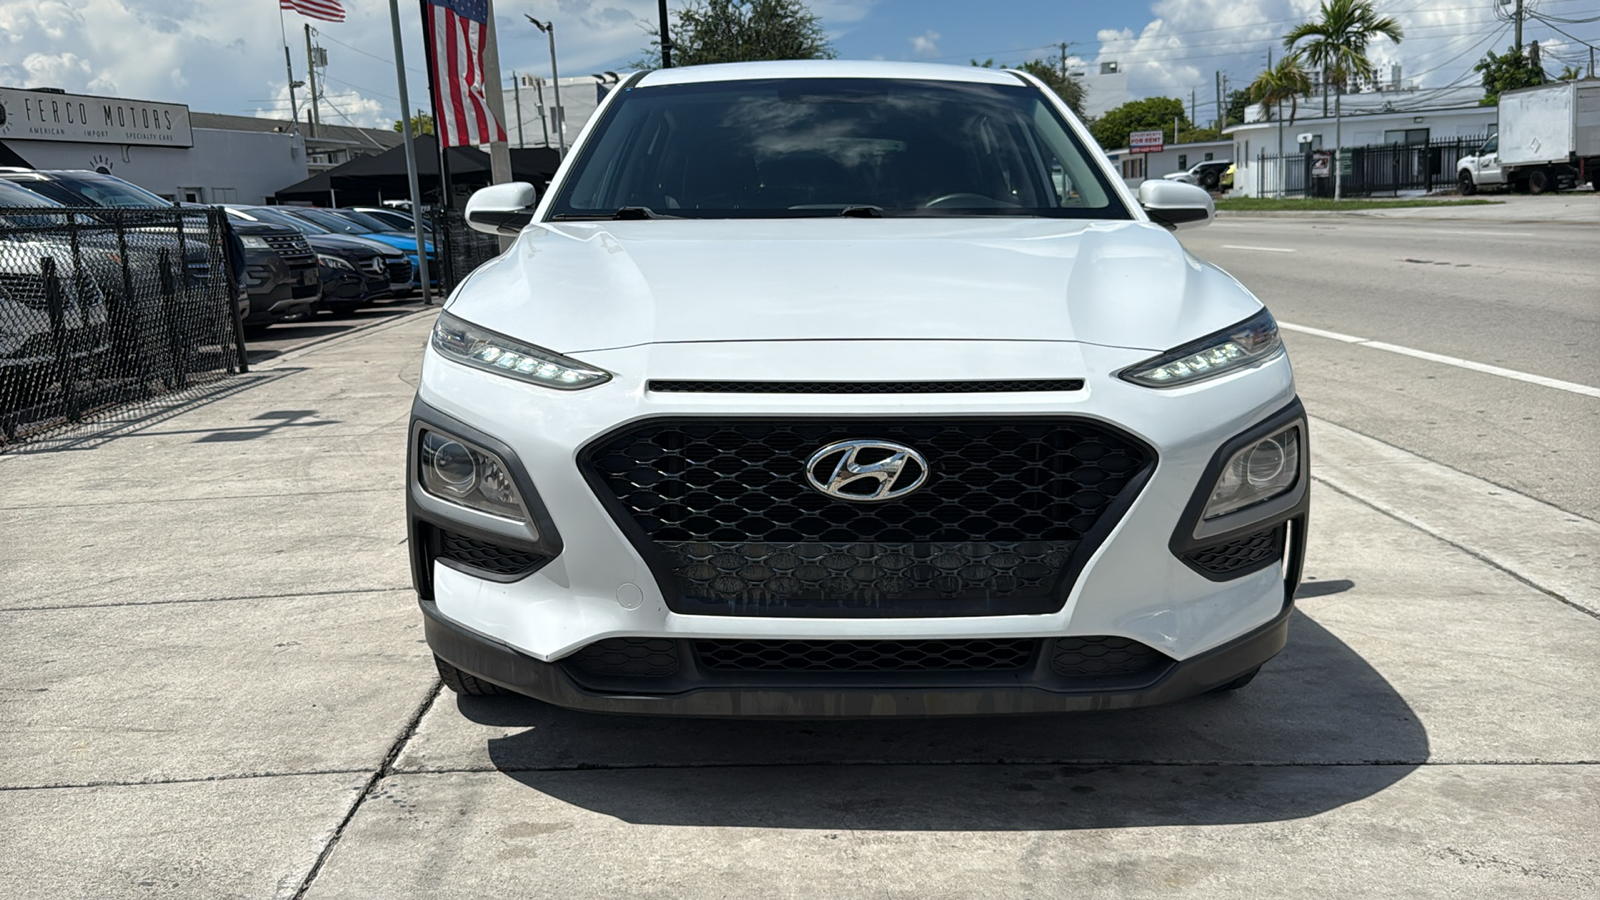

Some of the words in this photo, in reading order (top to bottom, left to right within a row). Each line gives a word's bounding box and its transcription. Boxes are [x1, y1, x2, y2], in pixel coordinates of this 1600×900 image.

[24, 98, 87, 125] FERCO
[103, 104, 172, 130] MOTORS
[29, 127, 65, 135] AMERICAN
[83, 130, 108, 138] IMPORT
[125, 132, 156, 140] SPECIALTY
